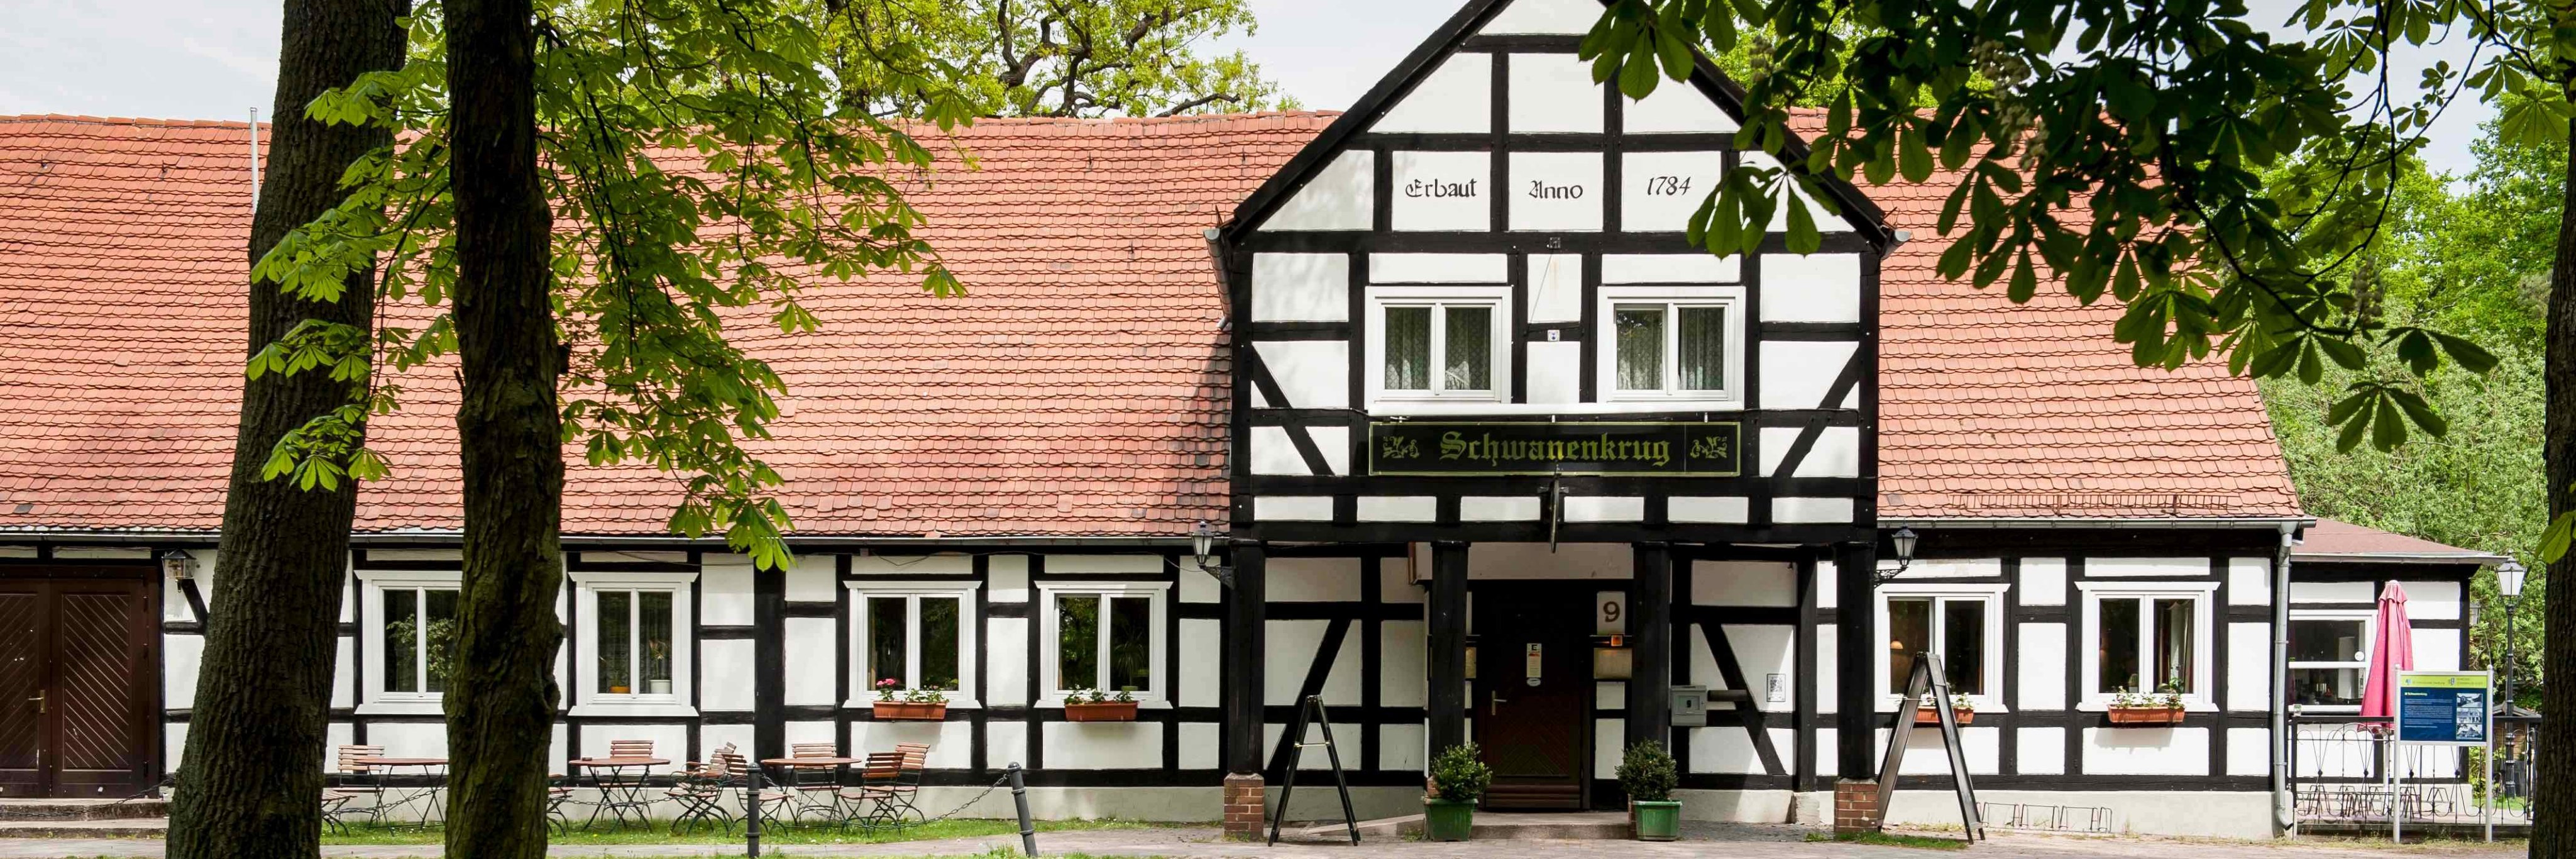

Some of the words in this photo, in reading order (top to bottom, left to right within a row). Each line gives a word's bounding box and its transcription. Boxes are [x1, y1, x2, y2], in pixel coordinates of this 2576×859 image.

[1405, 178, 1477, 198] Erbaut
[1529, 180, 1583, 199] Anno
[1647, 176, 1691, 196] 1784
[1439, 431, 1671, 467] Schwanenkrug
[1603, 601, 1621, 623] 9
